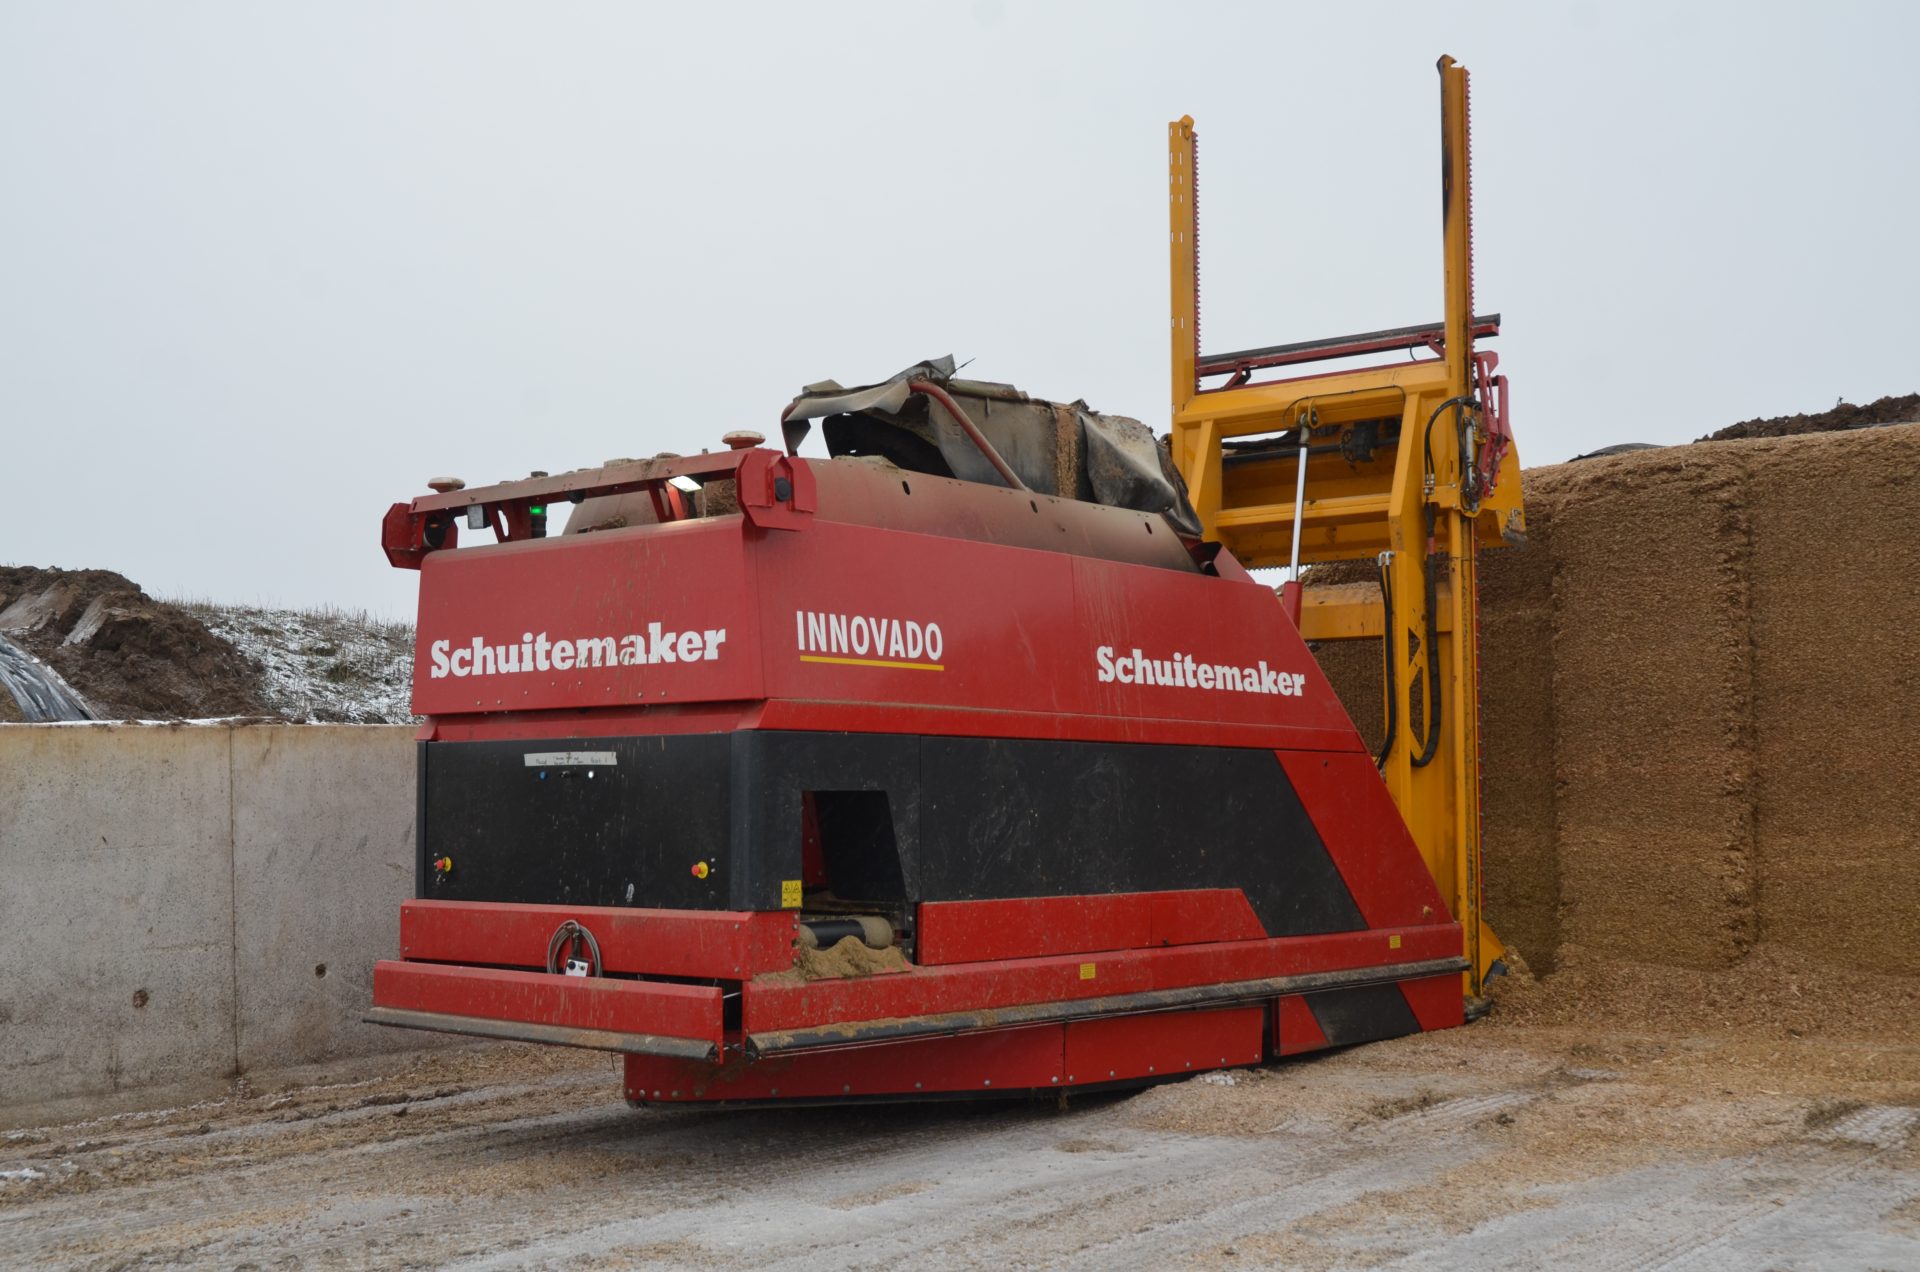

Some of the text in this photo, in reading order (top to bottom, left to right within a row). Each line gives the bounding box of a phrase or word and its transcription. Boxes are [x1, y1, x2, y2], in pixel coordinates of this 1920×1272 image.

[430, 621, 727, 679] Schuitemaker
[796, 610, 943, 661] INNOVADO
[1096, 645, 1306, 697] Schuitemaker
